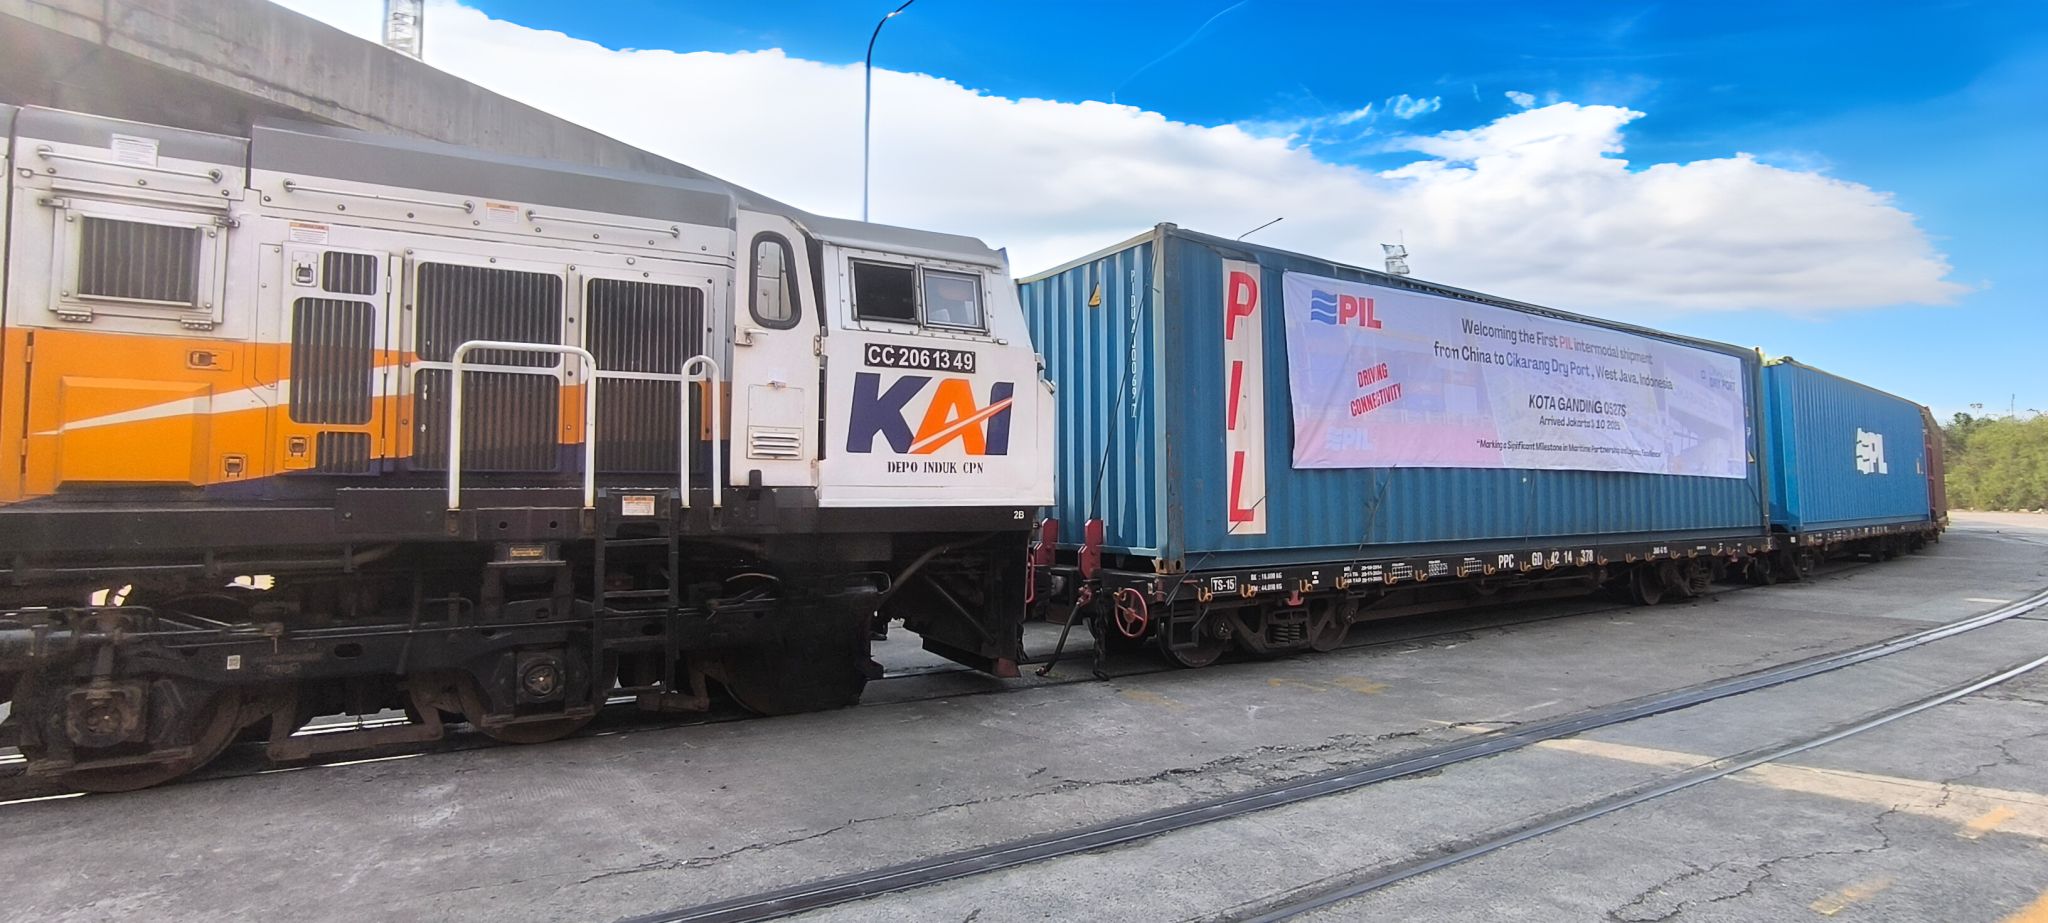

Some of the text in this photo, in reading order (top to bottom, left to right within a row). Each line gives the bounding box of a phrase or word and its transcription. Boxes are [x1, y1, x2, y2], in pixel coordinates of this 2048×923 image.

[1339, 294, 1382, 329] PIL
[1461, 318, 1517, 345] Welcoming
[1519, 328, 1535, 344] the
[1536, 332, 1558, 348] First
[1559, 335, 1573, 350] PIL
[1574, 337, 1619, 359] intermodal
[867, 346, 973, 370] CC 206 13 49
[1434, 341, 1459, 359] from
[1461, 345, 1492, 364] China
[1494, 351, 1504, 365] to
[1506, 352, 1550, 375] Cikarang
[1551, 358, 1569, 377] Dry
[1596, 365, 1618, 381] West
[1225, 271, 1258, 522] PIL
[1350, 383, 1402, 417] CONNECTIVITY
[1528, 394, 1556, 411] KOTA
[1557, 397, 1603, 414] GANDING
[846, 371, 1015, 455] KAI
[1539, 415, 1565, 427] Arrived
[887, 461, 984, 474] DEPO INDUK CPN
[1013, 510, 1025, 520] 2B
[1498, 554, 1515, 569] PPC
[1531, 552, 1543, 566] GD
[1550, 551, 1560, 565] 42
[1563, 550, 1573, 564] 14
[1213, 579, 1235, 591] TS-15
